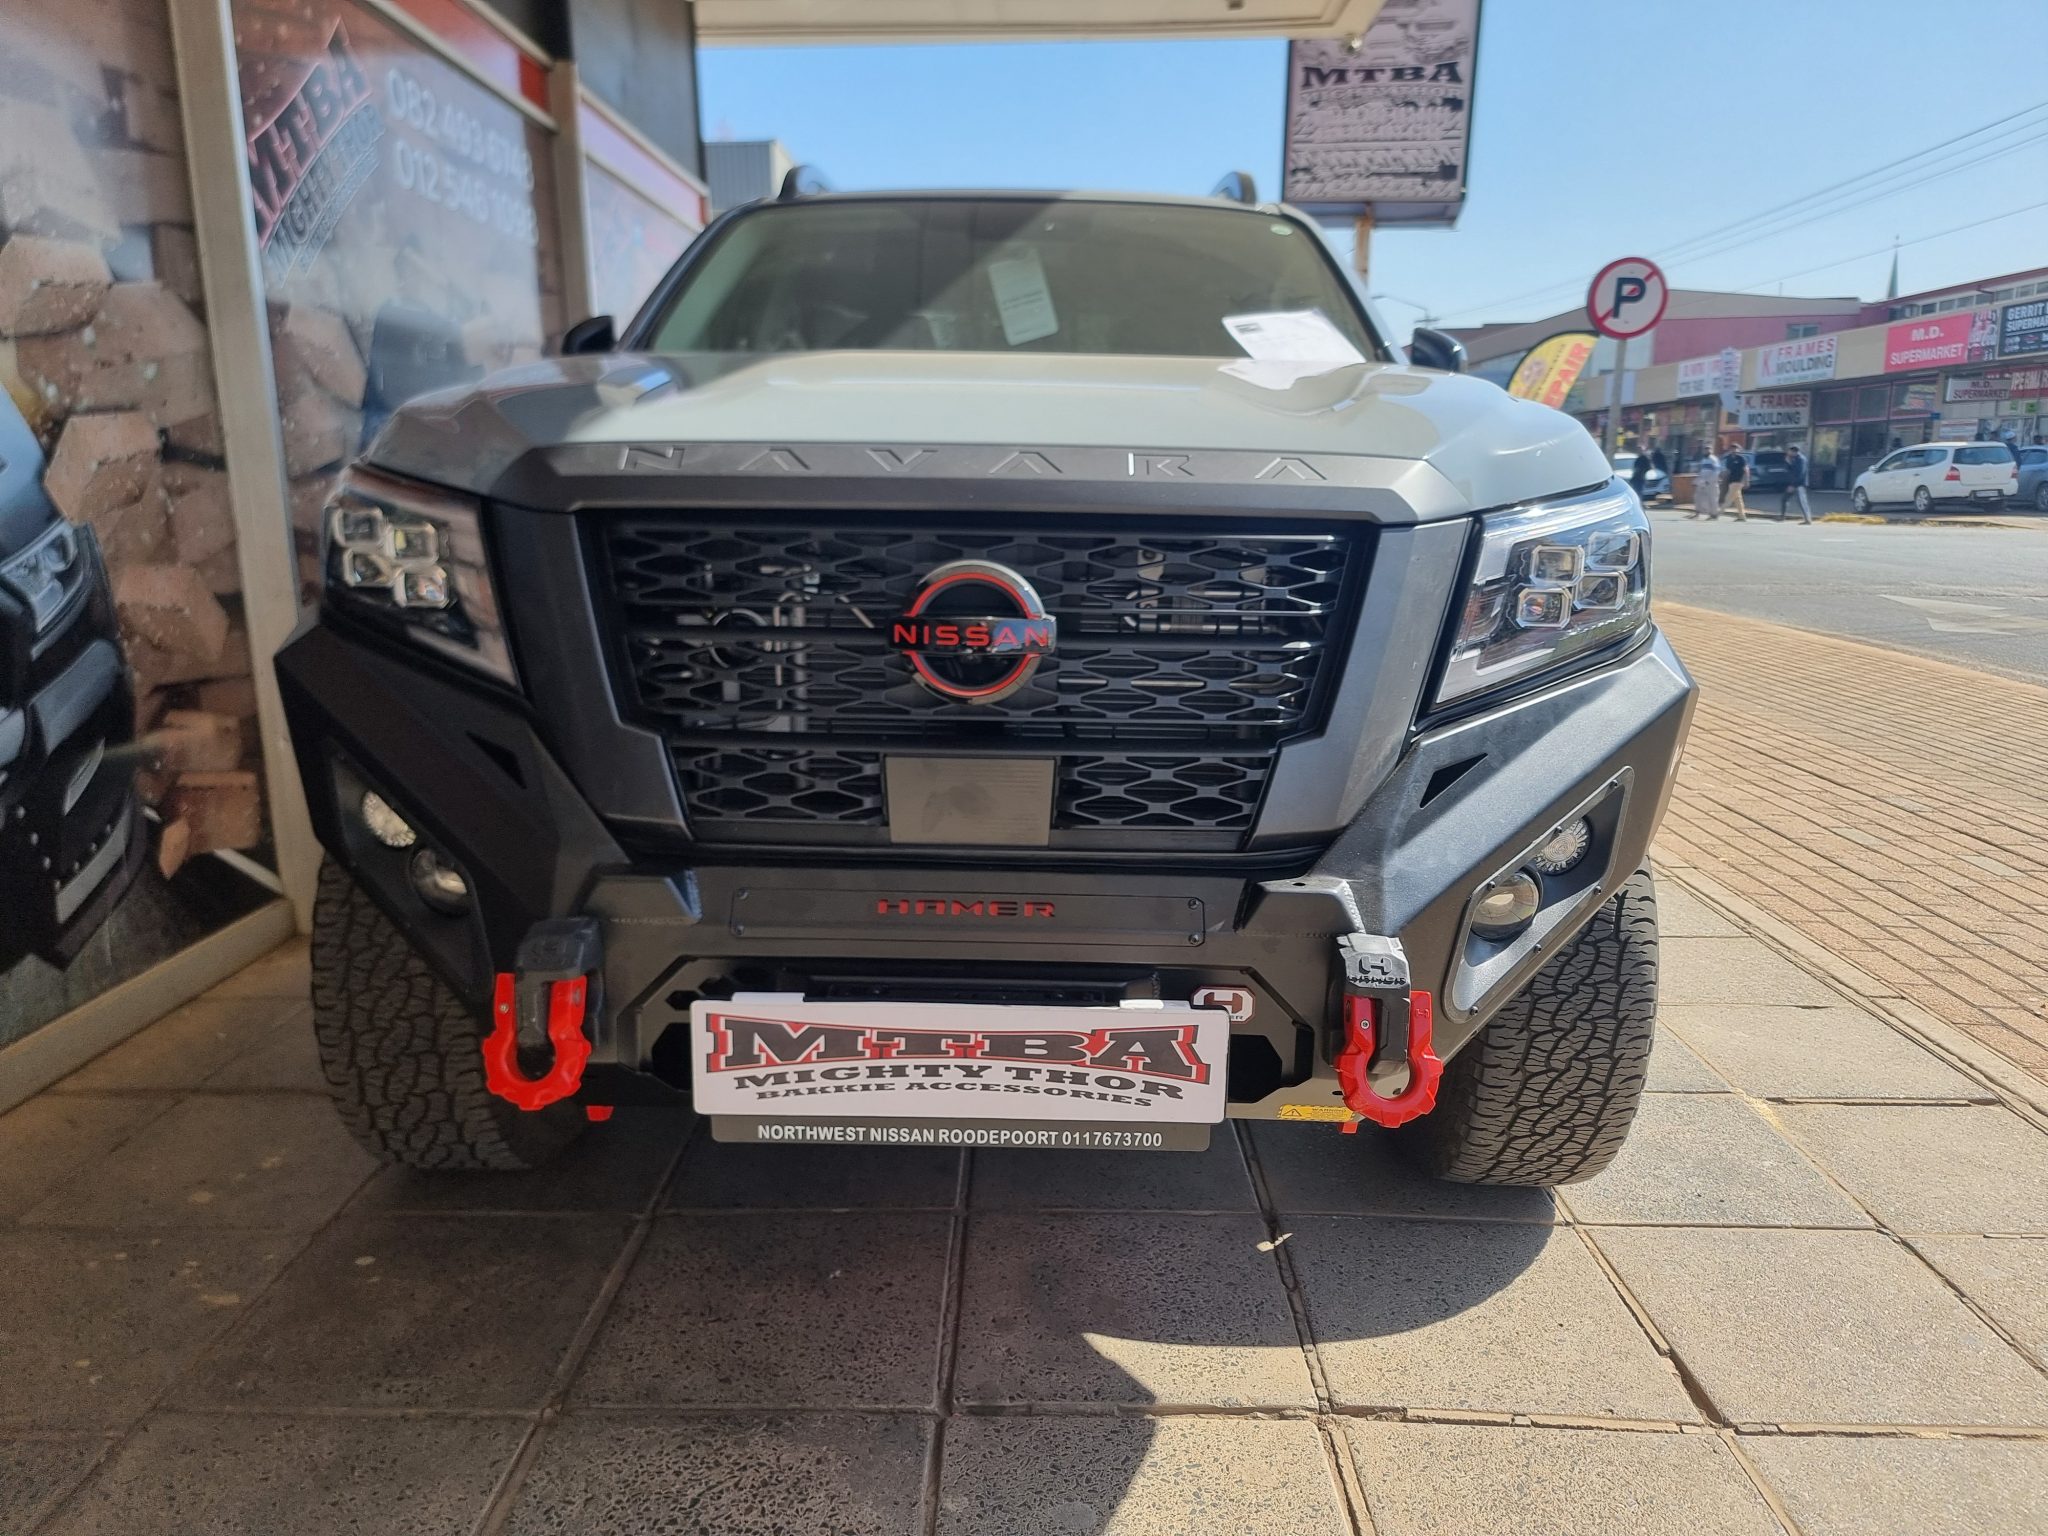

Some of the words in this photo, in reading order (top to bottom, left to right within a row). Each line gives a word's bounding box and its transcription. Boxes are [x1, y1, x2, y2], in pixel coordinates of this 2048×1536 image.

[1301, 62, 1464, 88] MTBA
[1613, 277, 1647, 318] P
[2007, 303, 2045, 320] GERRIT
[1911, 326, 1944, 342] M.D.
[1778, 337, 1835, 361] FRAMES
[1890, 343, 1964, 365] SUPERMARKET
[1775, 353, 1833, 375] MOULDING
[1760, 393, 1809, 409] FRAMES
[1953, 388, 2010, 400] SUPERMARKET
[1747, 410, 1801, 426] MOULDING
[619, 446, 1328, 482] NAVARA
[893, 624, 1049, 647] NISSAN
[877, 899, 1055, 917] HAMER
[707, 1014, 1211, 1085] MTBA
[733, 1064, 993, 1090] MIGHTY
[1004, 1066, 1183, 1100] THOR
[756, 1082, 896, 1100] BAKKIE
[905, 1081, 1152, 1108] ACCESSORIES
[758, 1124, 866, 1142] NORTHWEST
[869, 1127, 934, 1143] NISSAN
[938, 1128, 1059, 1146] ROODEPOORT
[1062, 1131, 1163, 1147] 0117673700
